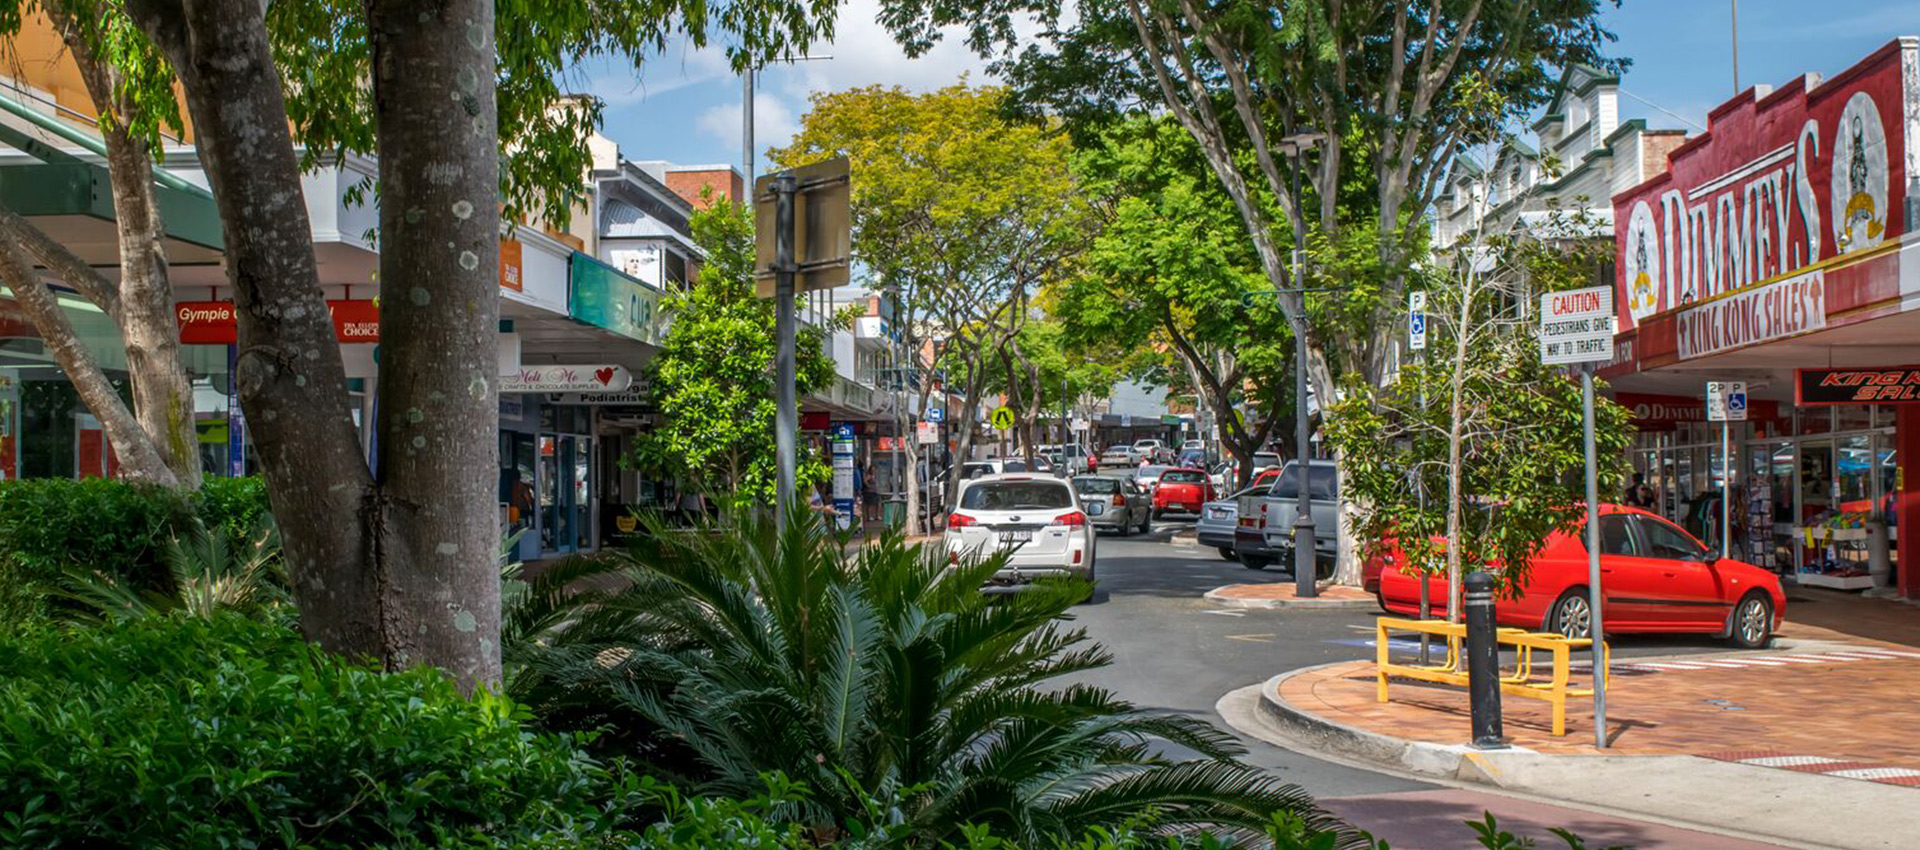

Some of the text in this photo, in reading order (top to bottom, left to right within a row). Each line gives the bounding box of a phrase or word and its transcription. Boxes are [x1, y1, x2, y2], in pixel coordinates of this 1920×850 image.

[1661, 119, 1821, 310] DIMMEYS
[1414, 294, 1421, 308] P
[1552, 292, 1601, 316] CAUTION
[179, 307, 230, 323] Gympie
[1689, 278, 1809, 355] KING KONG SALES
[343, 328, 379, 336] CHOICE
[1544, 317, 1610, 337] PEDESTRIANS GIVE
[1547, 339, 1605, 356] WAY TO TRAFFIC
[1820, 371, 1904, 386] KING
[1710, 383, 1725, 393] 2P
[1733, 383, 1741, 393] P
[1852, 385, 1920, 400] SAL
